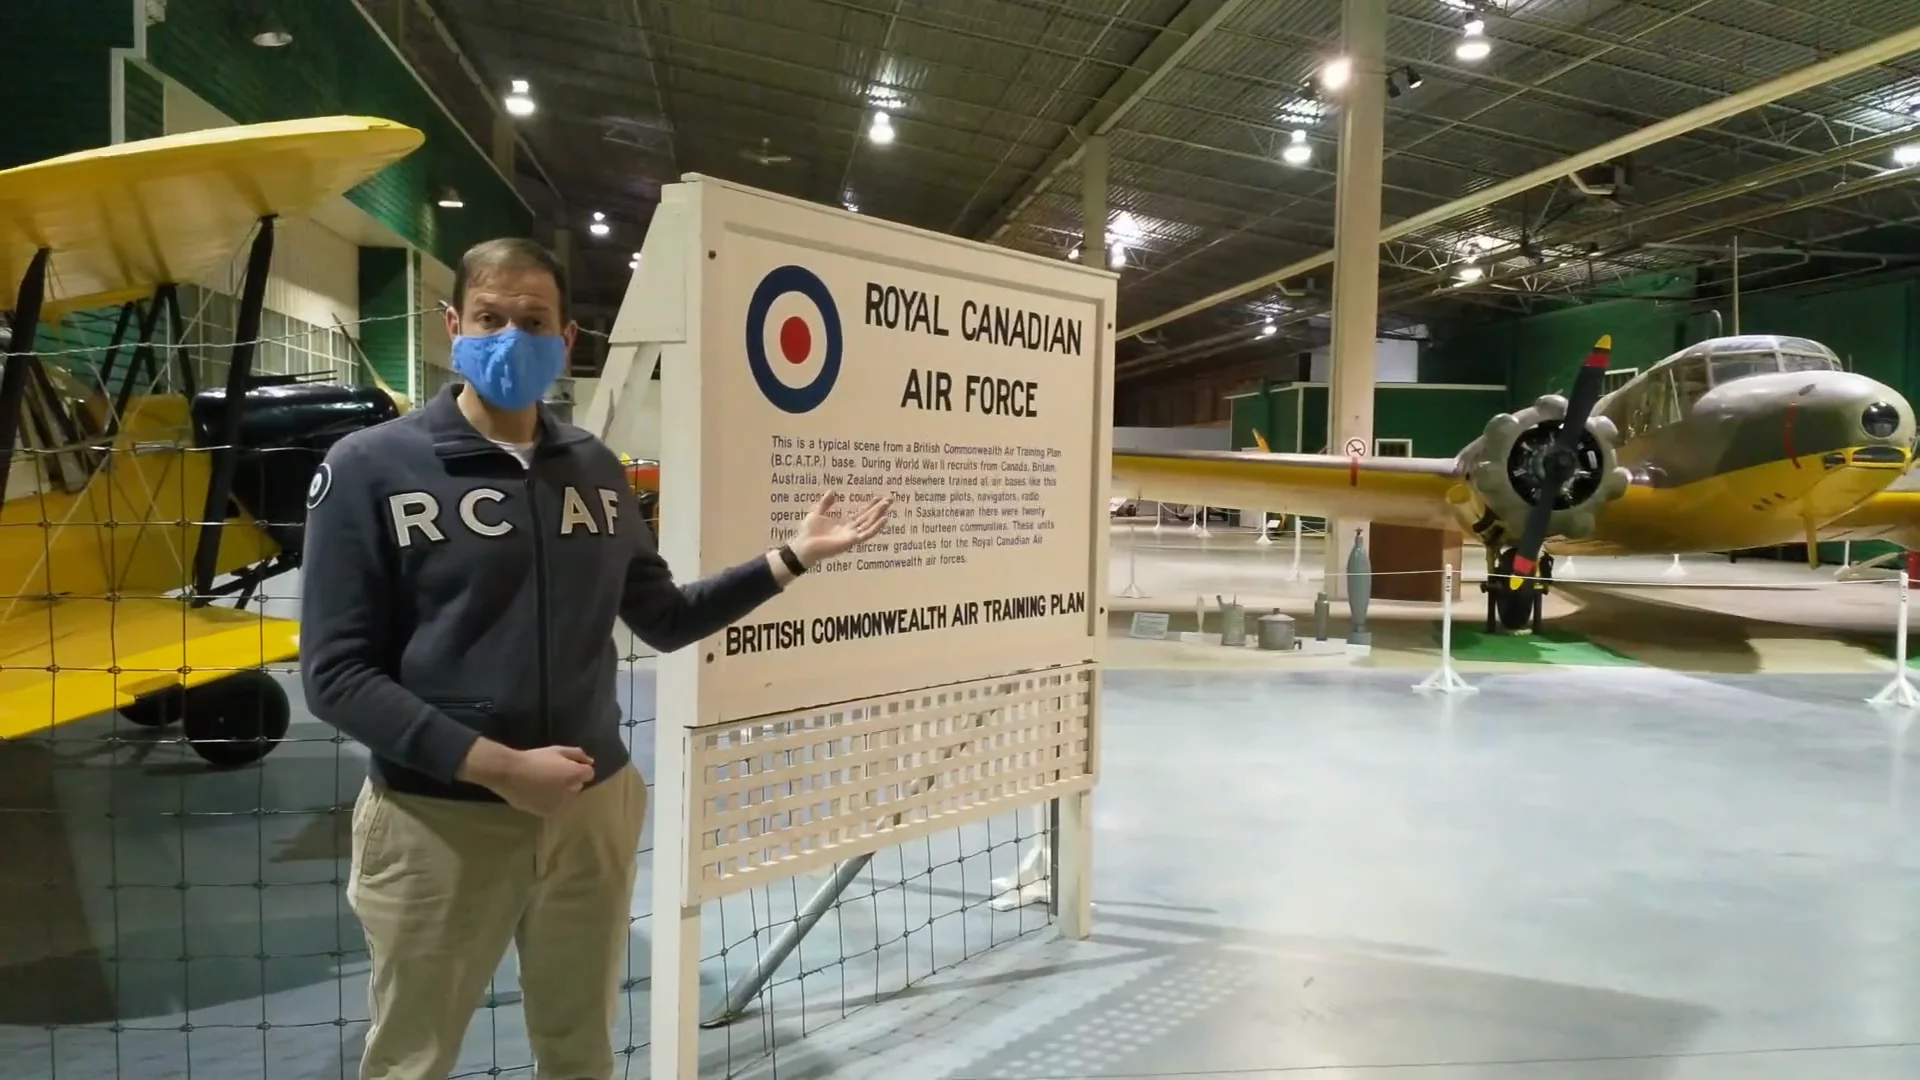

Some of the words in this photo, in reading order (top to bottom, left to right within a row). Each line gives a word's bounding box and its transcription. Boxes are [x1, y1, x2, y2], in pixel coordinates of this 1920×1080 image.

[865, 282, 949, 337] ROYAL
[961, 300, 1082, 356] CANADIAN
[900, 368, 952, 412] AIR
[966, 375, 1038, 417] FORCE
[771, 435, 792, 449] This
[796, 437, 805, 449] is
[809, 439, 815, 449] a
[818, 438, 850, 452] typical
[853, 441, 880, 451] scene
[883, 441, 903, 452] from
[906, 443, 912, 452] a
[913, 442, 940, 454] British
[943, 443, 1002, 456] Commonwealth
[1004, 446, 1015, 456] Air
[1017, 446, 1045, 459] Training
[1046, 448, 1062, 458] Plan
[771, 453, 826, 468] (B.C.A.T.P.)
[831, 456, 857, 468] base.
[862, 457, 891, 471] During
[895, 458, 919, 470] World
[922, 459, 938, 471] War
[947, 460, 978, 471] recruits
[980, 460, 998, 471] from
[771, 473, 820, 486] Australia,
[823, 473, 843, 485] New
[847, 474, 883, 485] Zealand
[886, 475, 902, 485] and
[905, 475, 945, 486] elsewhere
[948, 476, 978, 486] trained
[980, 477, 988, 486] at
[991, 476, 1001, 486] air
[1004, 476, 1026, 486] bases
[1028, 475, 1041, 486] like
[1043, 475, 1057, 486] this
[770, 492, 789, 502] one
[890, 491, 910, 503] They
[914, 491, 946, 502] became
[1021, 491, 1040, 501] radio
[771, 509, 808, 522] operat
[916, 507, 975, 518] Saskatchewan
[979, 508, 999, 517] there
[1001, 508, 1018, 516] were
[1022, 506, 1046, 517] twenty
[879, 524, 905, 535] cated
[910, 524, 918, 534] in
[922, 522, 957, 534] fourteen
[1012, 520, 1034, 531] These
[1037, 520, 1055, 530] units
[893, 540, 937, 554] graduates
[940, 538, 952, 549] for
[956, 538, 969, 548] the
[972, 536, 994, 549] Royal
[996, 535, 1030, 546] Canadian
[1032, 535, 1043, 545] Air
[826, 560, 852, 572] other
[856, 556, 923, 571] Commonwealth
[925, 556, 937, 566] air
[725, 619, 805, 657] BRITISH
[811, 604, 948, 645] COMMONWEALTH
[951, 600, 979, 628] AIR
[983, 594, 1047, 622] TRAINING
[1050, 590, 1086, 616] PLAN
